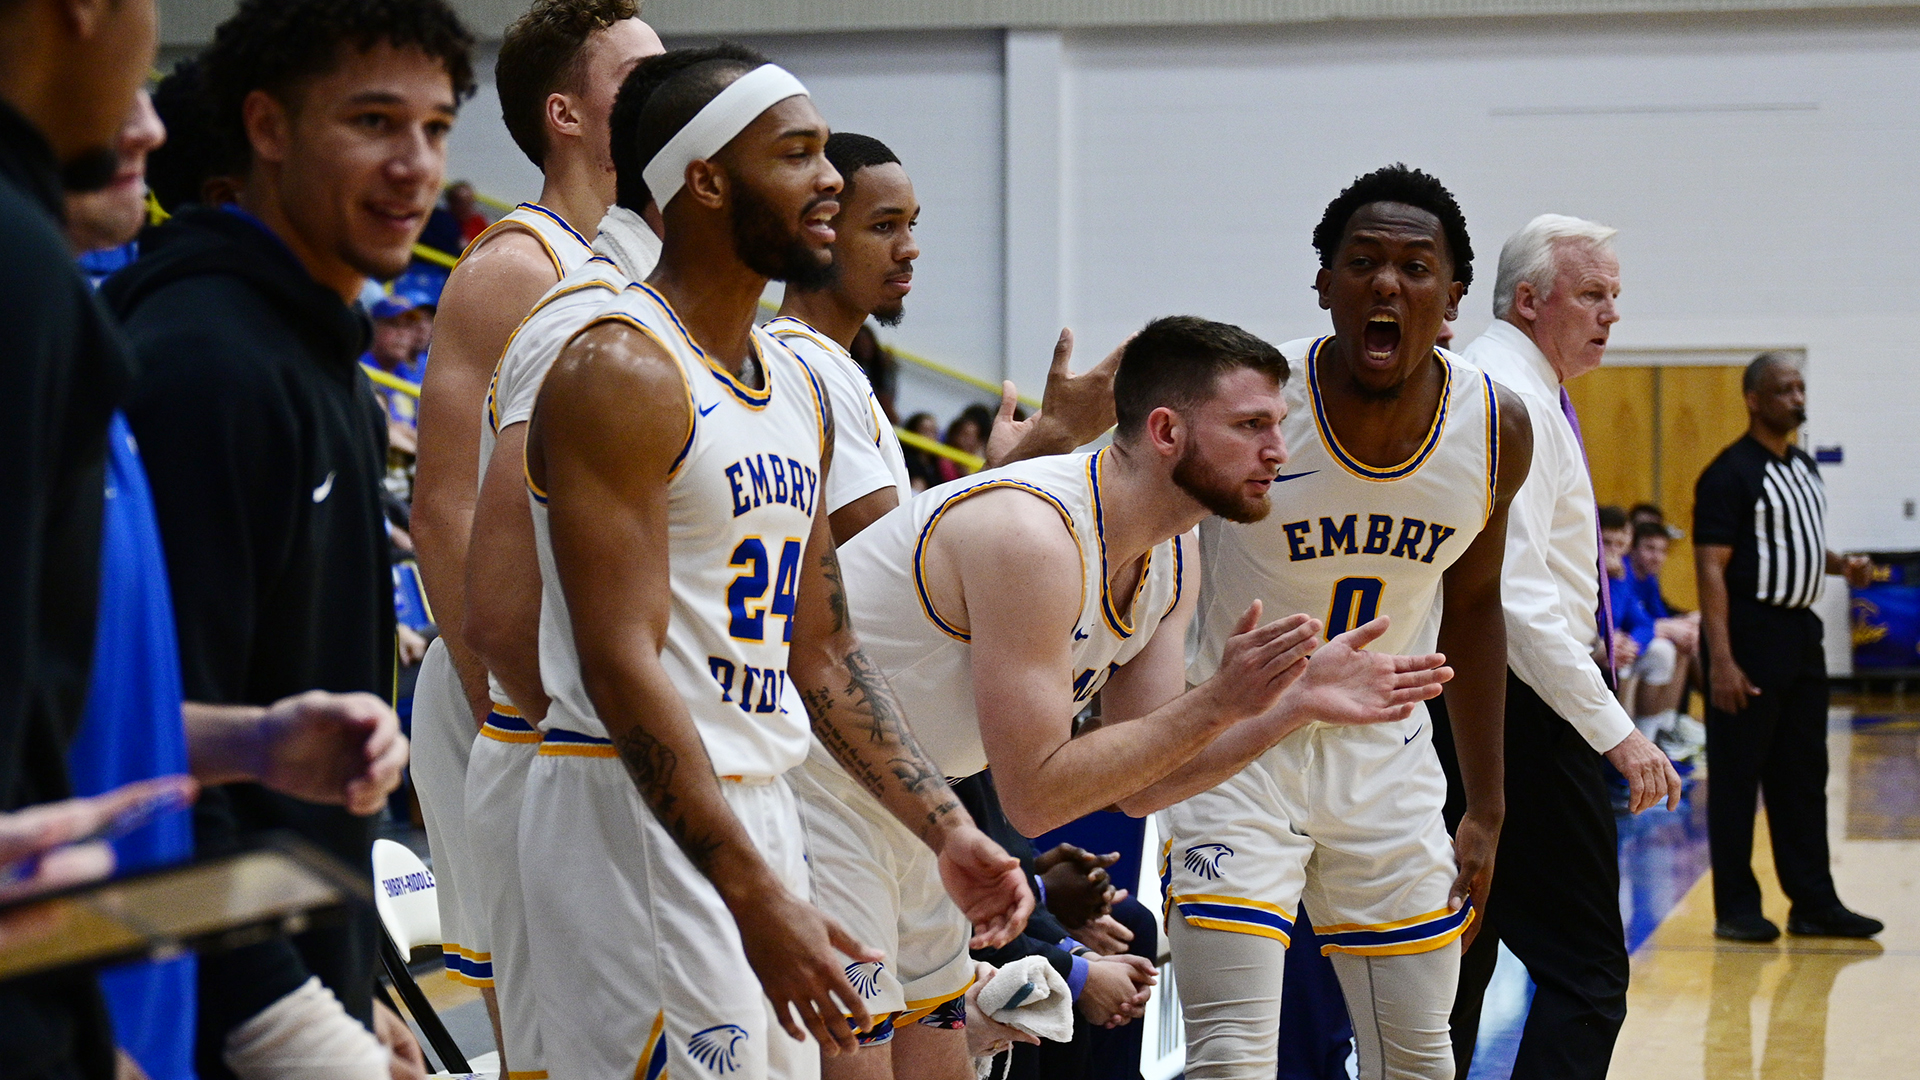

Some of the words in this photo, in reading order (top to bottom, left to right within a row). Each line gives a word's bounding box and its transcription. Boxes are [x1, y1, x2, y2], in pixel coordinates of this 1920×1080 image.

[724, 453, 818, 519] EMBRY
[1282, 513, 1457, 565] EMBRY
[725, 535, 802, 646] 24
[1323, 575, 1387, 649] 0
[382, 870, 436, 898] EMBRY-RIDDLE
